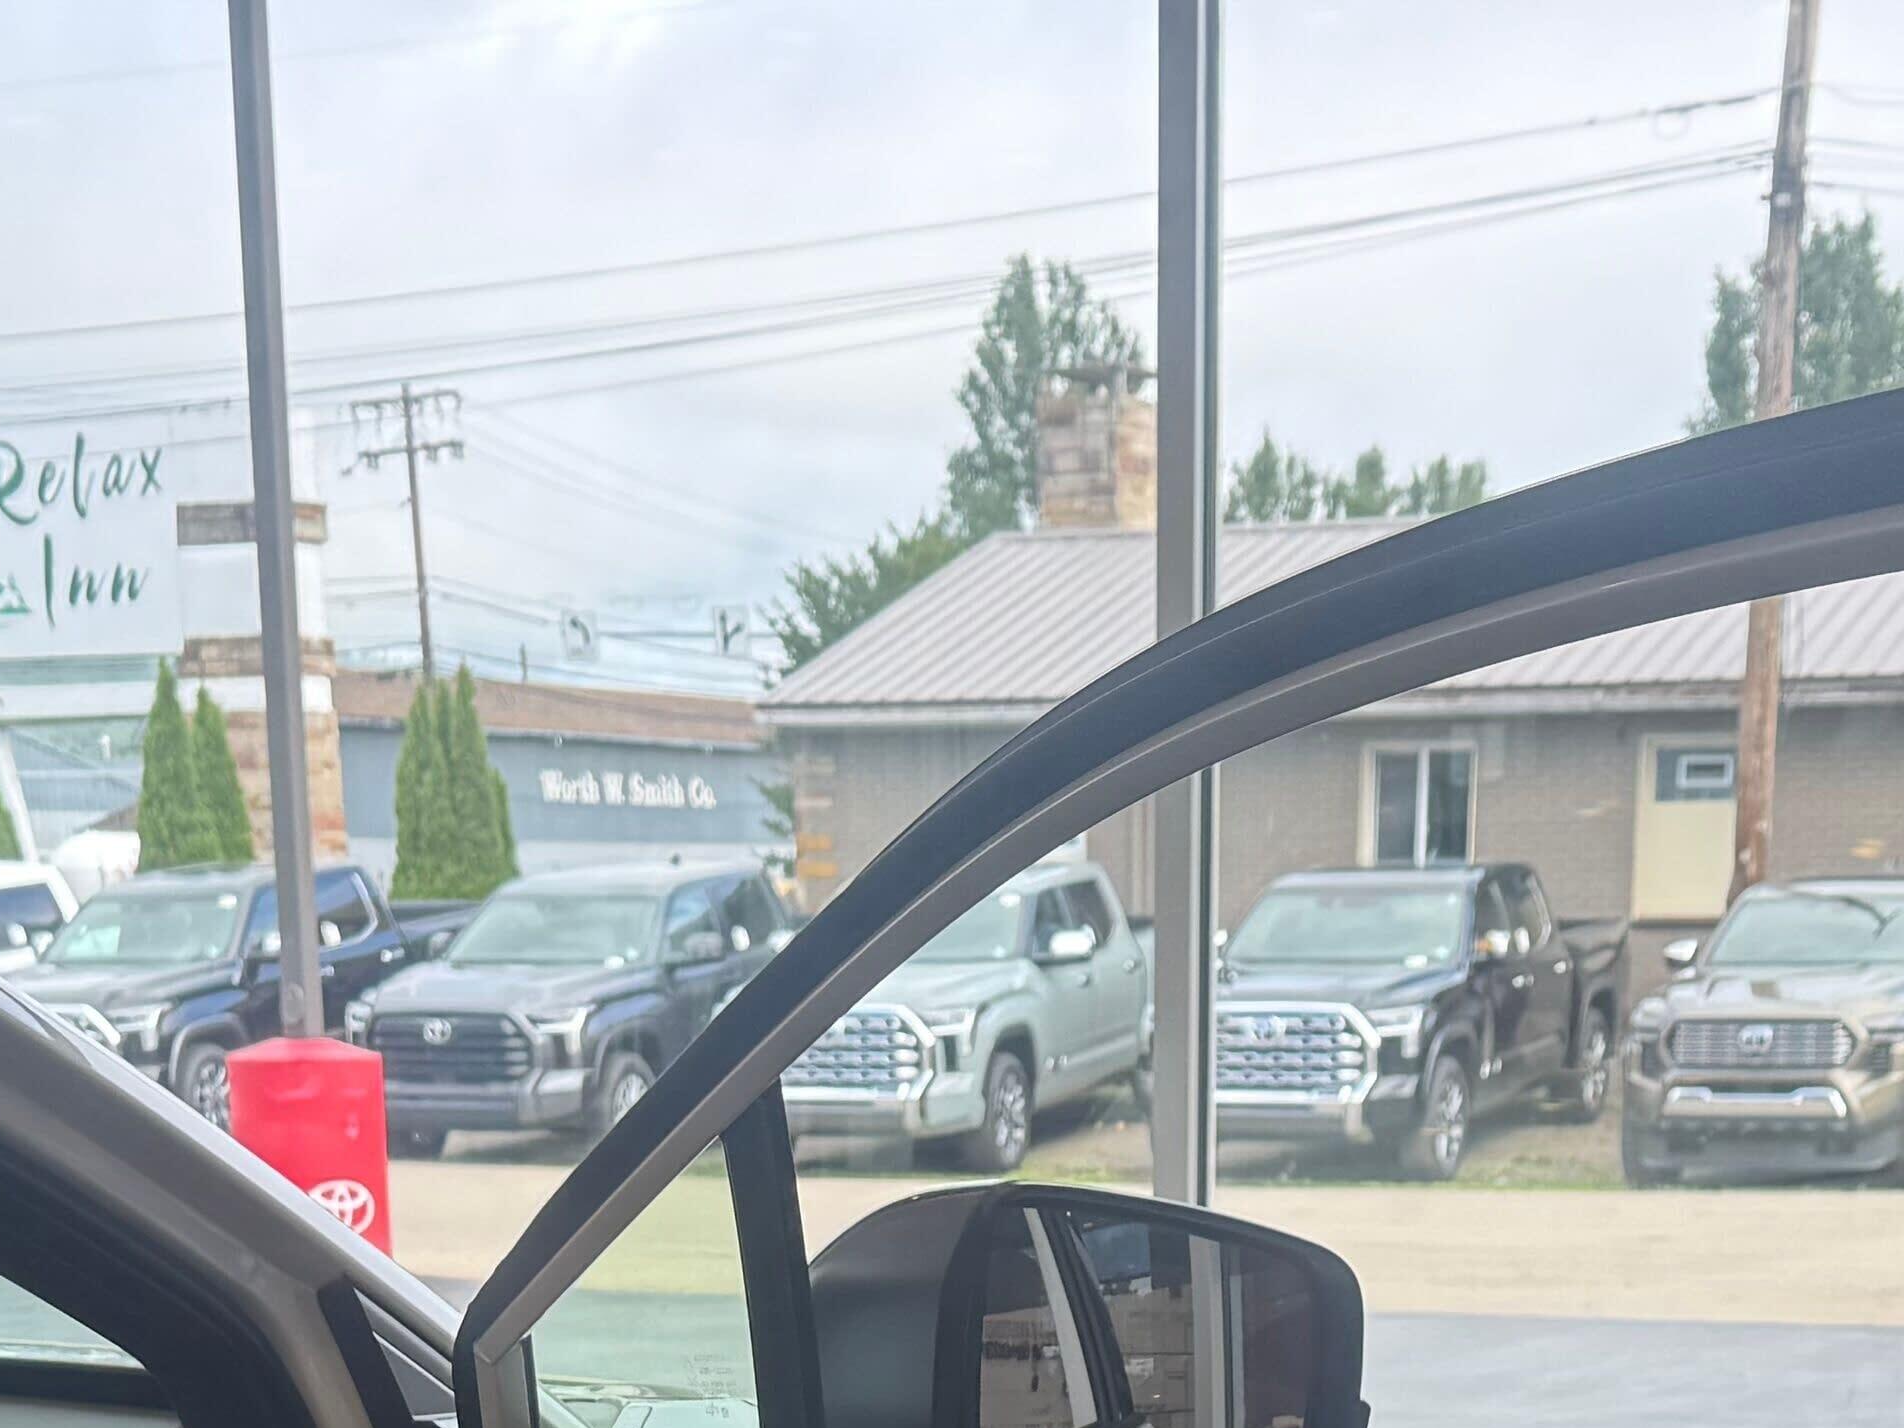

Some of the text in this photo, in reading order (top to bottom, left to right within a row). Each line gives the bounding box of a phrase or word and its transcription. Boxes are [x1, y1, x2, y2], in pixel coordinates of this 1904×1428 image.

[43, 531, 148, 630] Inn
[539, 768, 600, 805] Worth
[628, 772, 685, 808] Smith
